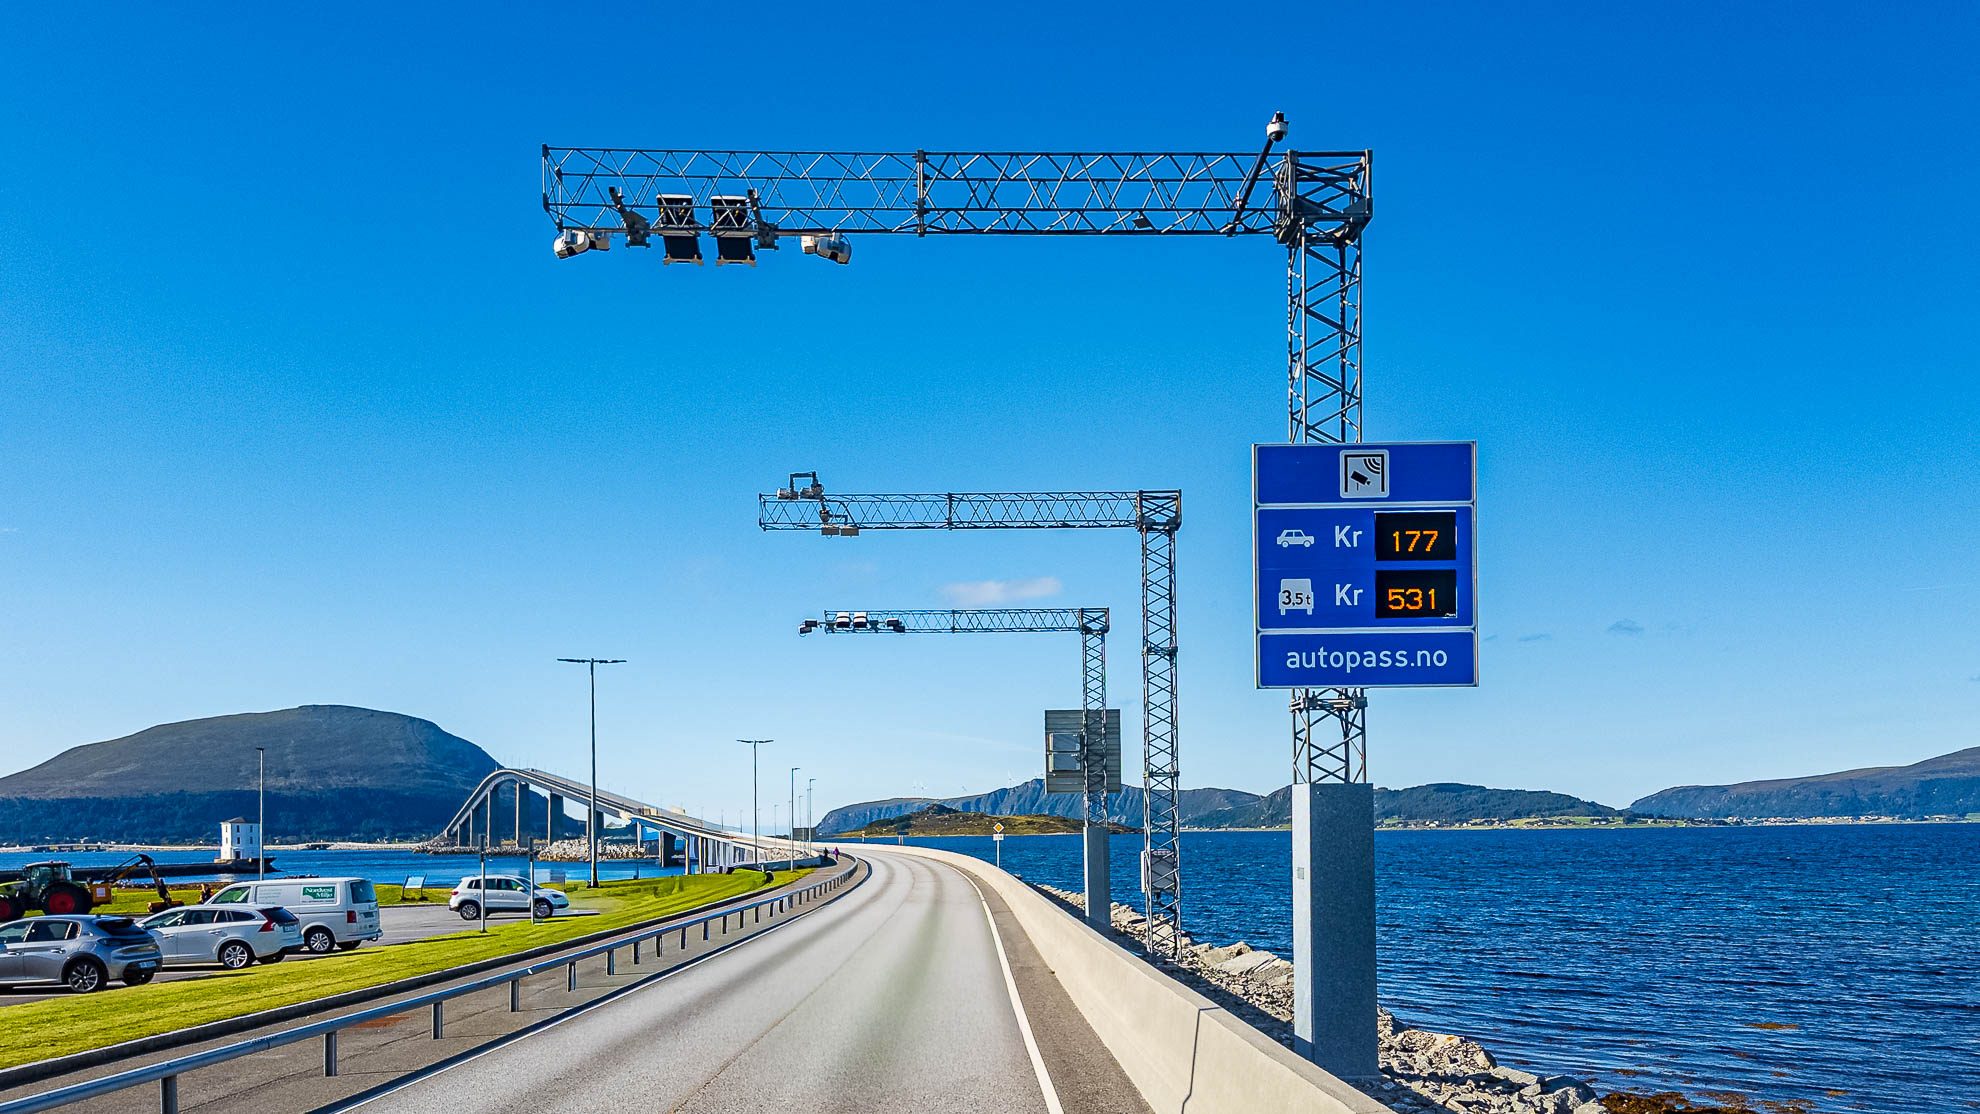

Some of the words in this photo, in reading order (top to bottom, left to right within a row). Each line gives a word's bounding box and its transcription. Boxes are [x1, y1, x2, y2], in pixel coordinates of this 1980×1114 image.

[1334, 525, 1362, 547] Kr
[1392, 530, 1439, 552] 177
[1335, 583, 1363, 606] Kr
[1388, 588, 1436, 610] 531
[1286, 646, 1448, 673] autopass.no
